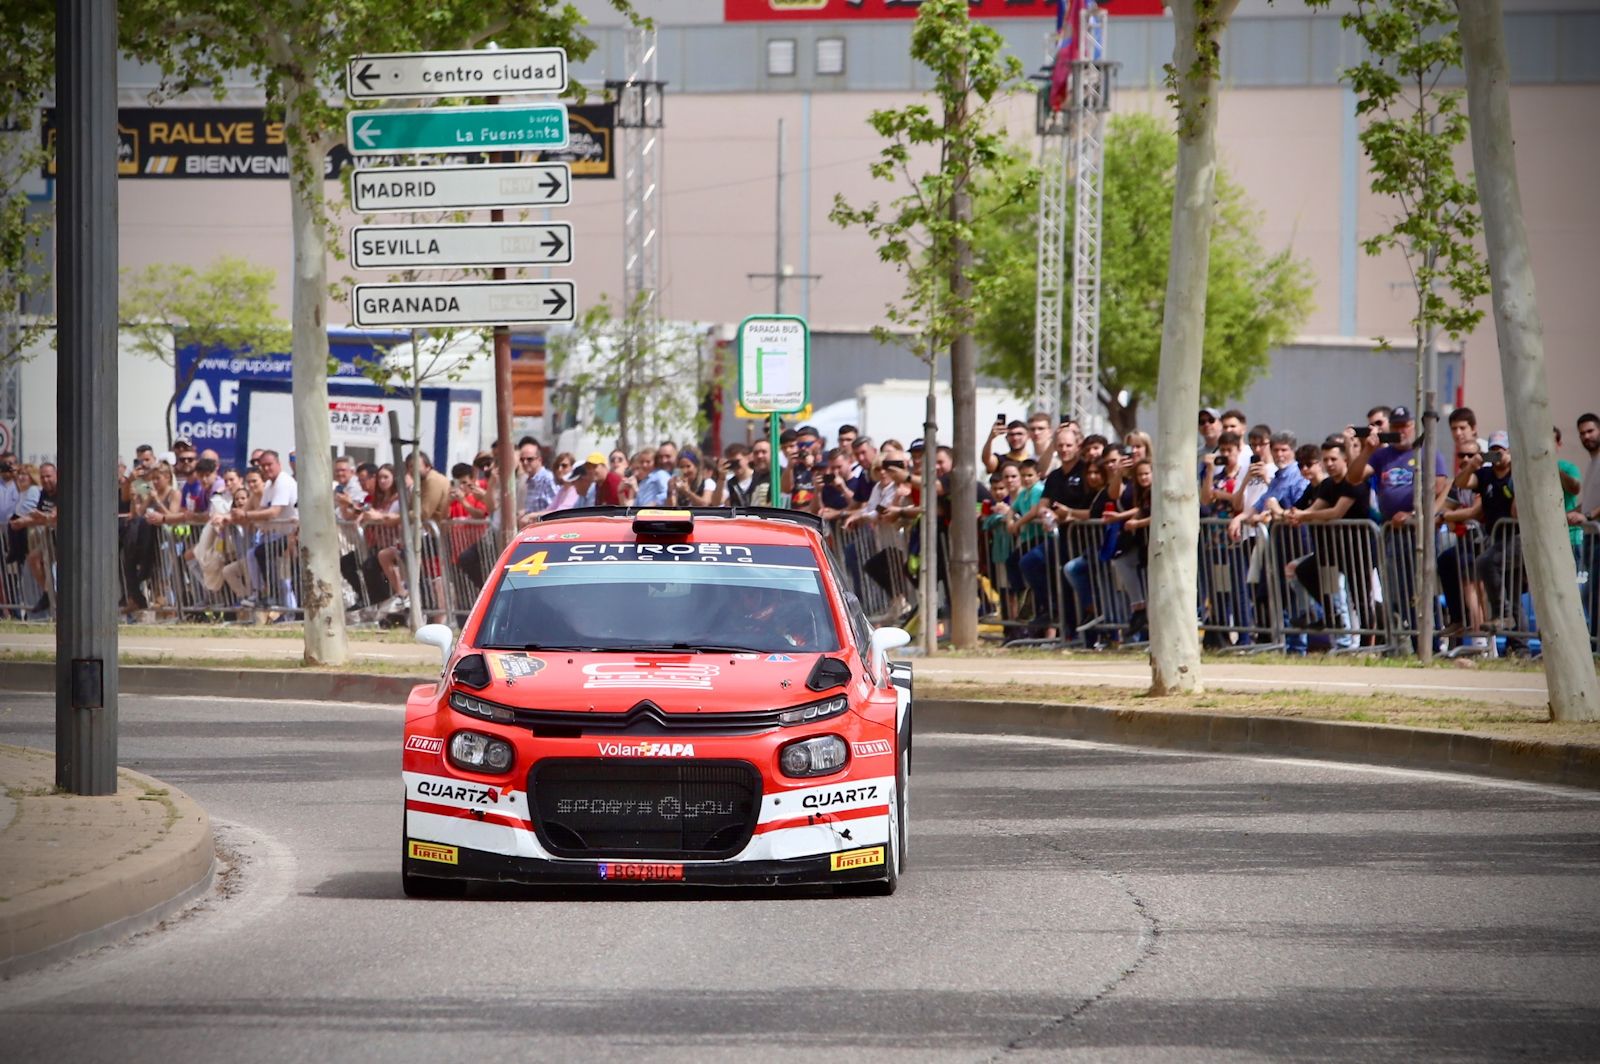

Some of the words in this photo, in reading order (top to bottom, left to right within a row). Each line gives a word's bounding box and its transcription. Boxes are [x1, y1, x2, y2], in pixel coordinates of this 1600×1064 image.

[423, 66, 483, 83] centro
[493, 64, 557, 81] ciudad
[150, 122, 254, 145] RALLYE
[456, 129, 474, 142] La
[481, 126, 560, 141] Fuensanta
[361, 181, 436, 198] MADRID
[362, 239, 440, 255] SEVILLA
[364, 296, 460, 314] GRANADA
[783, 326, 798, 334] BUS
[508, 551, 548, 576] 4
[411, 737, 441, 751] TURINI
[855, 741, 889, 754] TURINI
[417, 781, 489, 804] QUARTZ
[802, 785, 878, 808] QUARTZ
[413, 844, 454, 862] PIRELLI
[836, 850, 880, 868] PIRELLI
[614, 864, 676, 879] BG78UC
